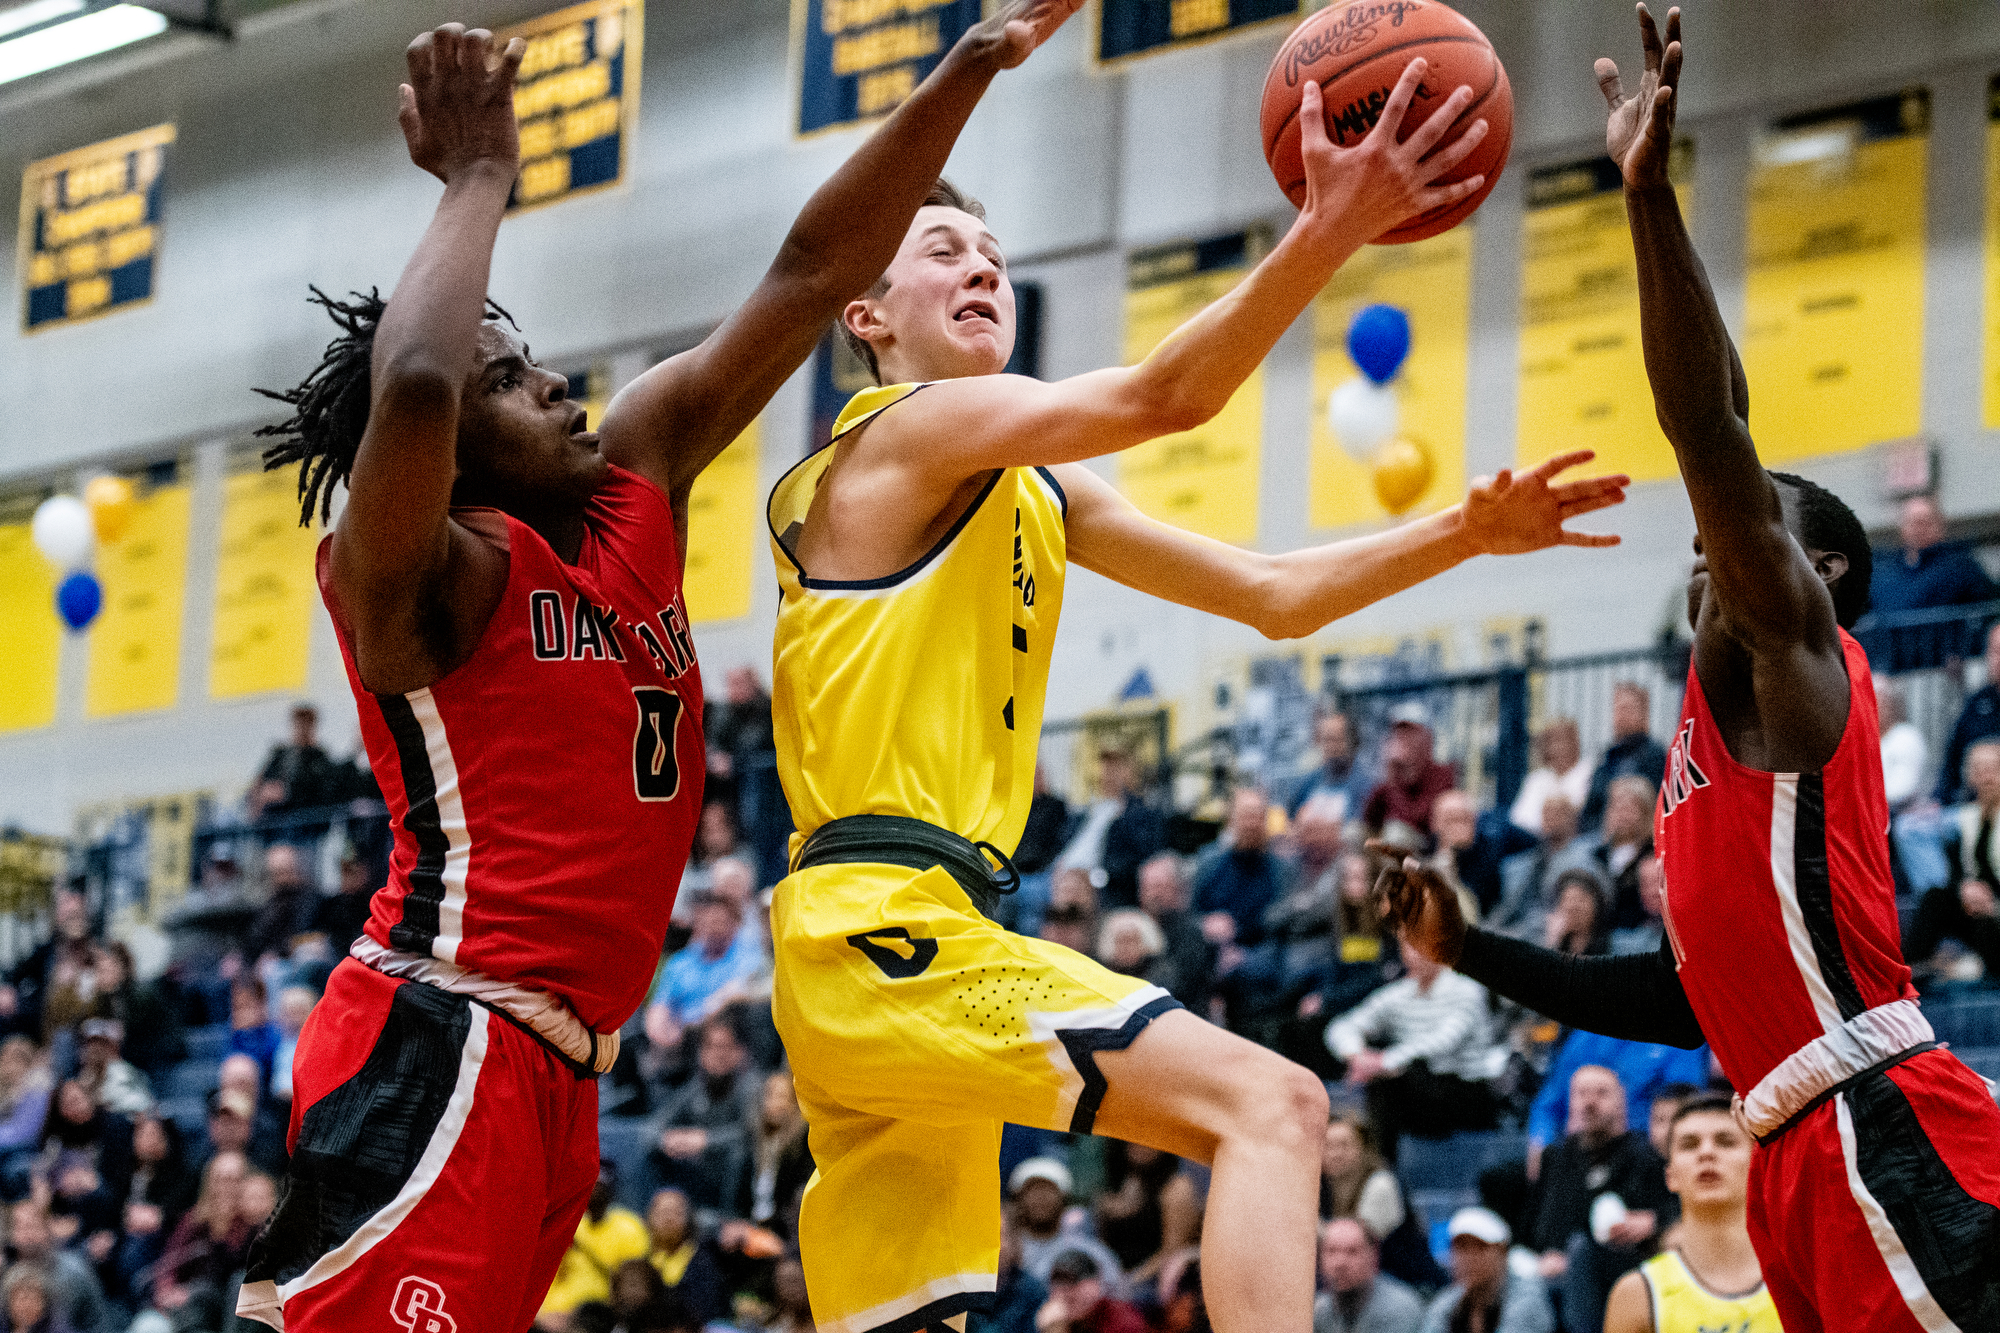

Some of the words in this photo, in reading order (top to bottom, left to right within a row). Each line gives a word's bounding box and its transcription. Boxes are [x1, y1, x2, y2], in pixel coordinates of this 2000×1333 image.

[1285, 1, 1422, 87] Rawlings
[530, 590, 627, 662] OAK
[632, 685, 684, 802] 0
